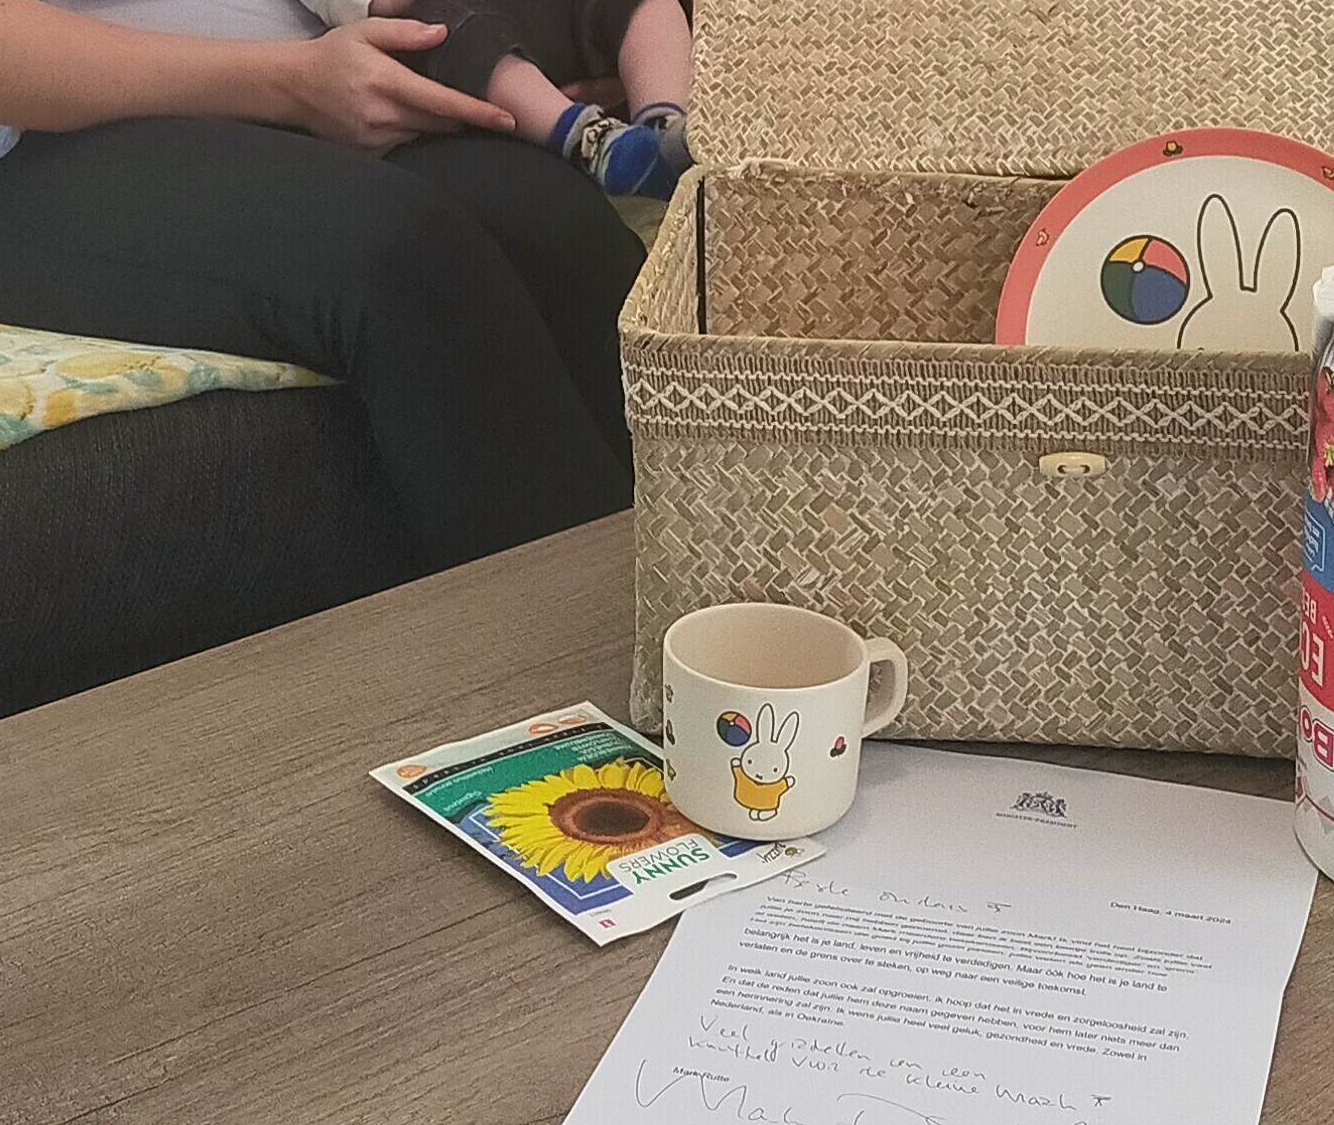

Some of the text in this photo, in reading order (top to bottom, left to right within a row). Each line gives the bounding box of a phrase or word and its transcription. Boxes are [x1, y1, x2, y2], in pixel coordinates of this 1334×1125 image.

[619, 838, 699, 872] FLOWERS
[632, 847, 710, 884] SUNNY
[1110, 901, 1131, 910] Den
[1174, 911, 1204, 921] maart
